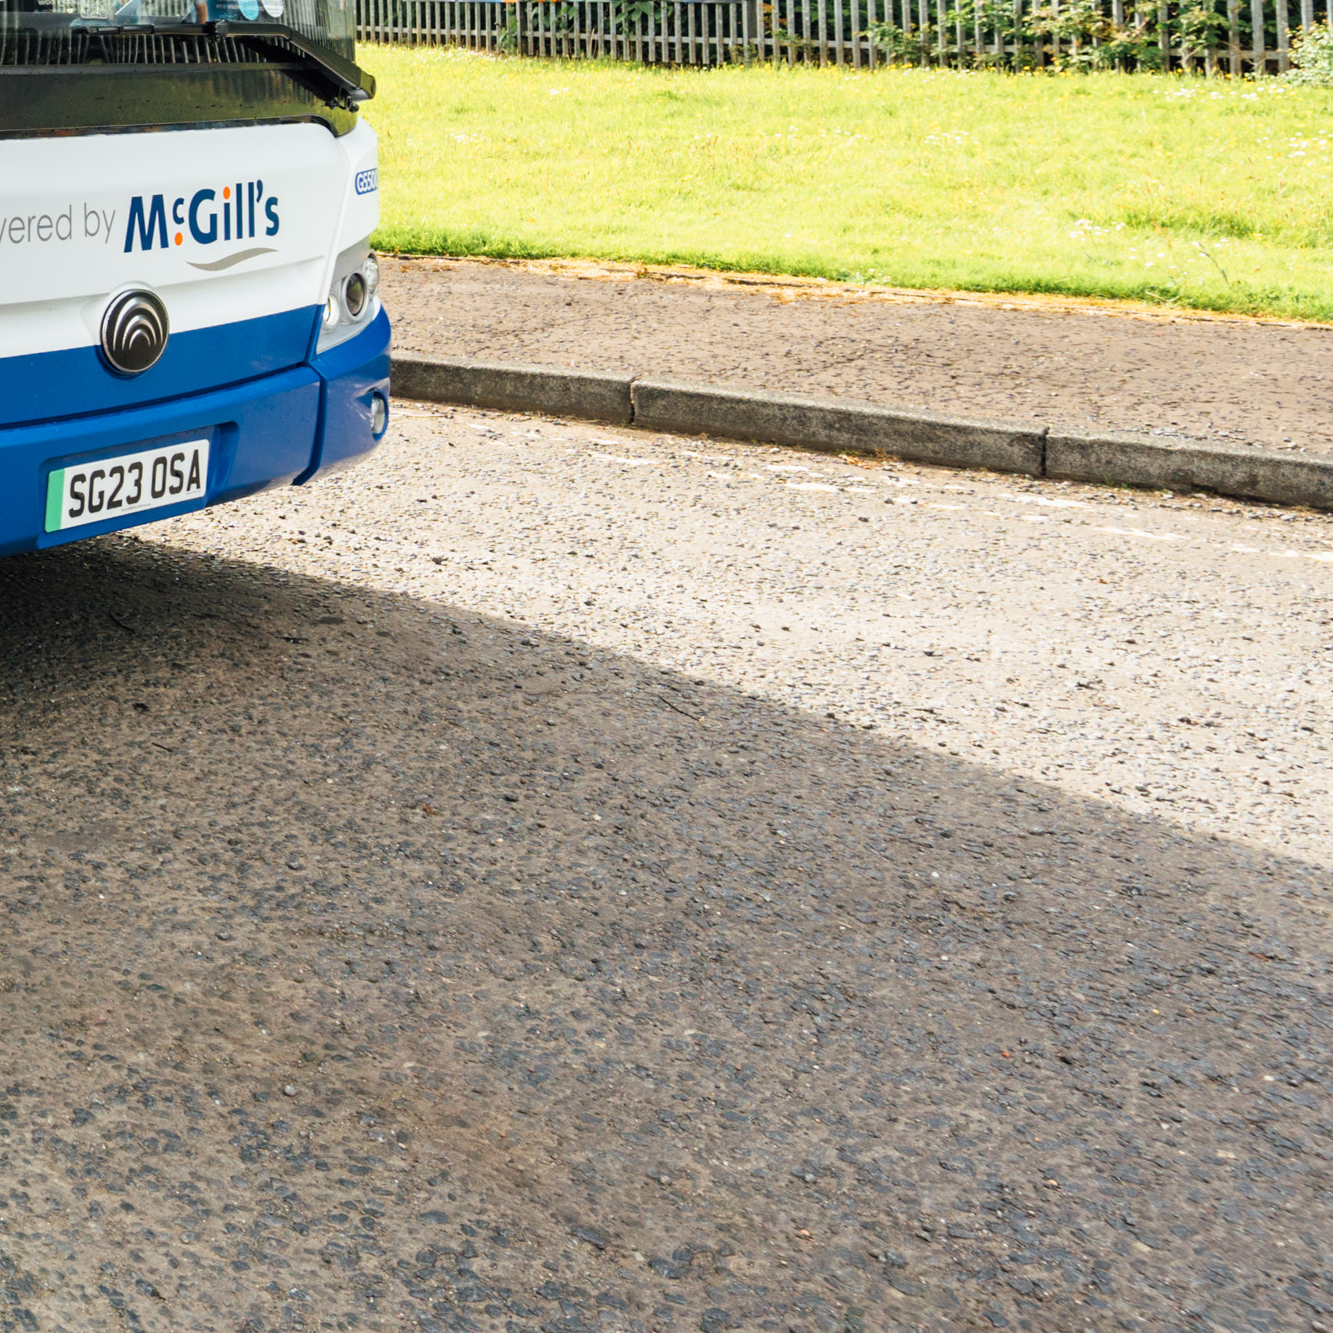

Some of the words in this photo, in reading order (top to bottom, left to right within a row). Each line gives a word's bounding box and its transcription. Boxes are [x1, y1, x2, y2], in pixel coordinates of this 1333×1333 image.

[83, 202, 116, 244] by
[123, 179, 280, 253] McGill's
[68, 461, 143, 518] SG23
[151, 449, 201, 499] OSA
